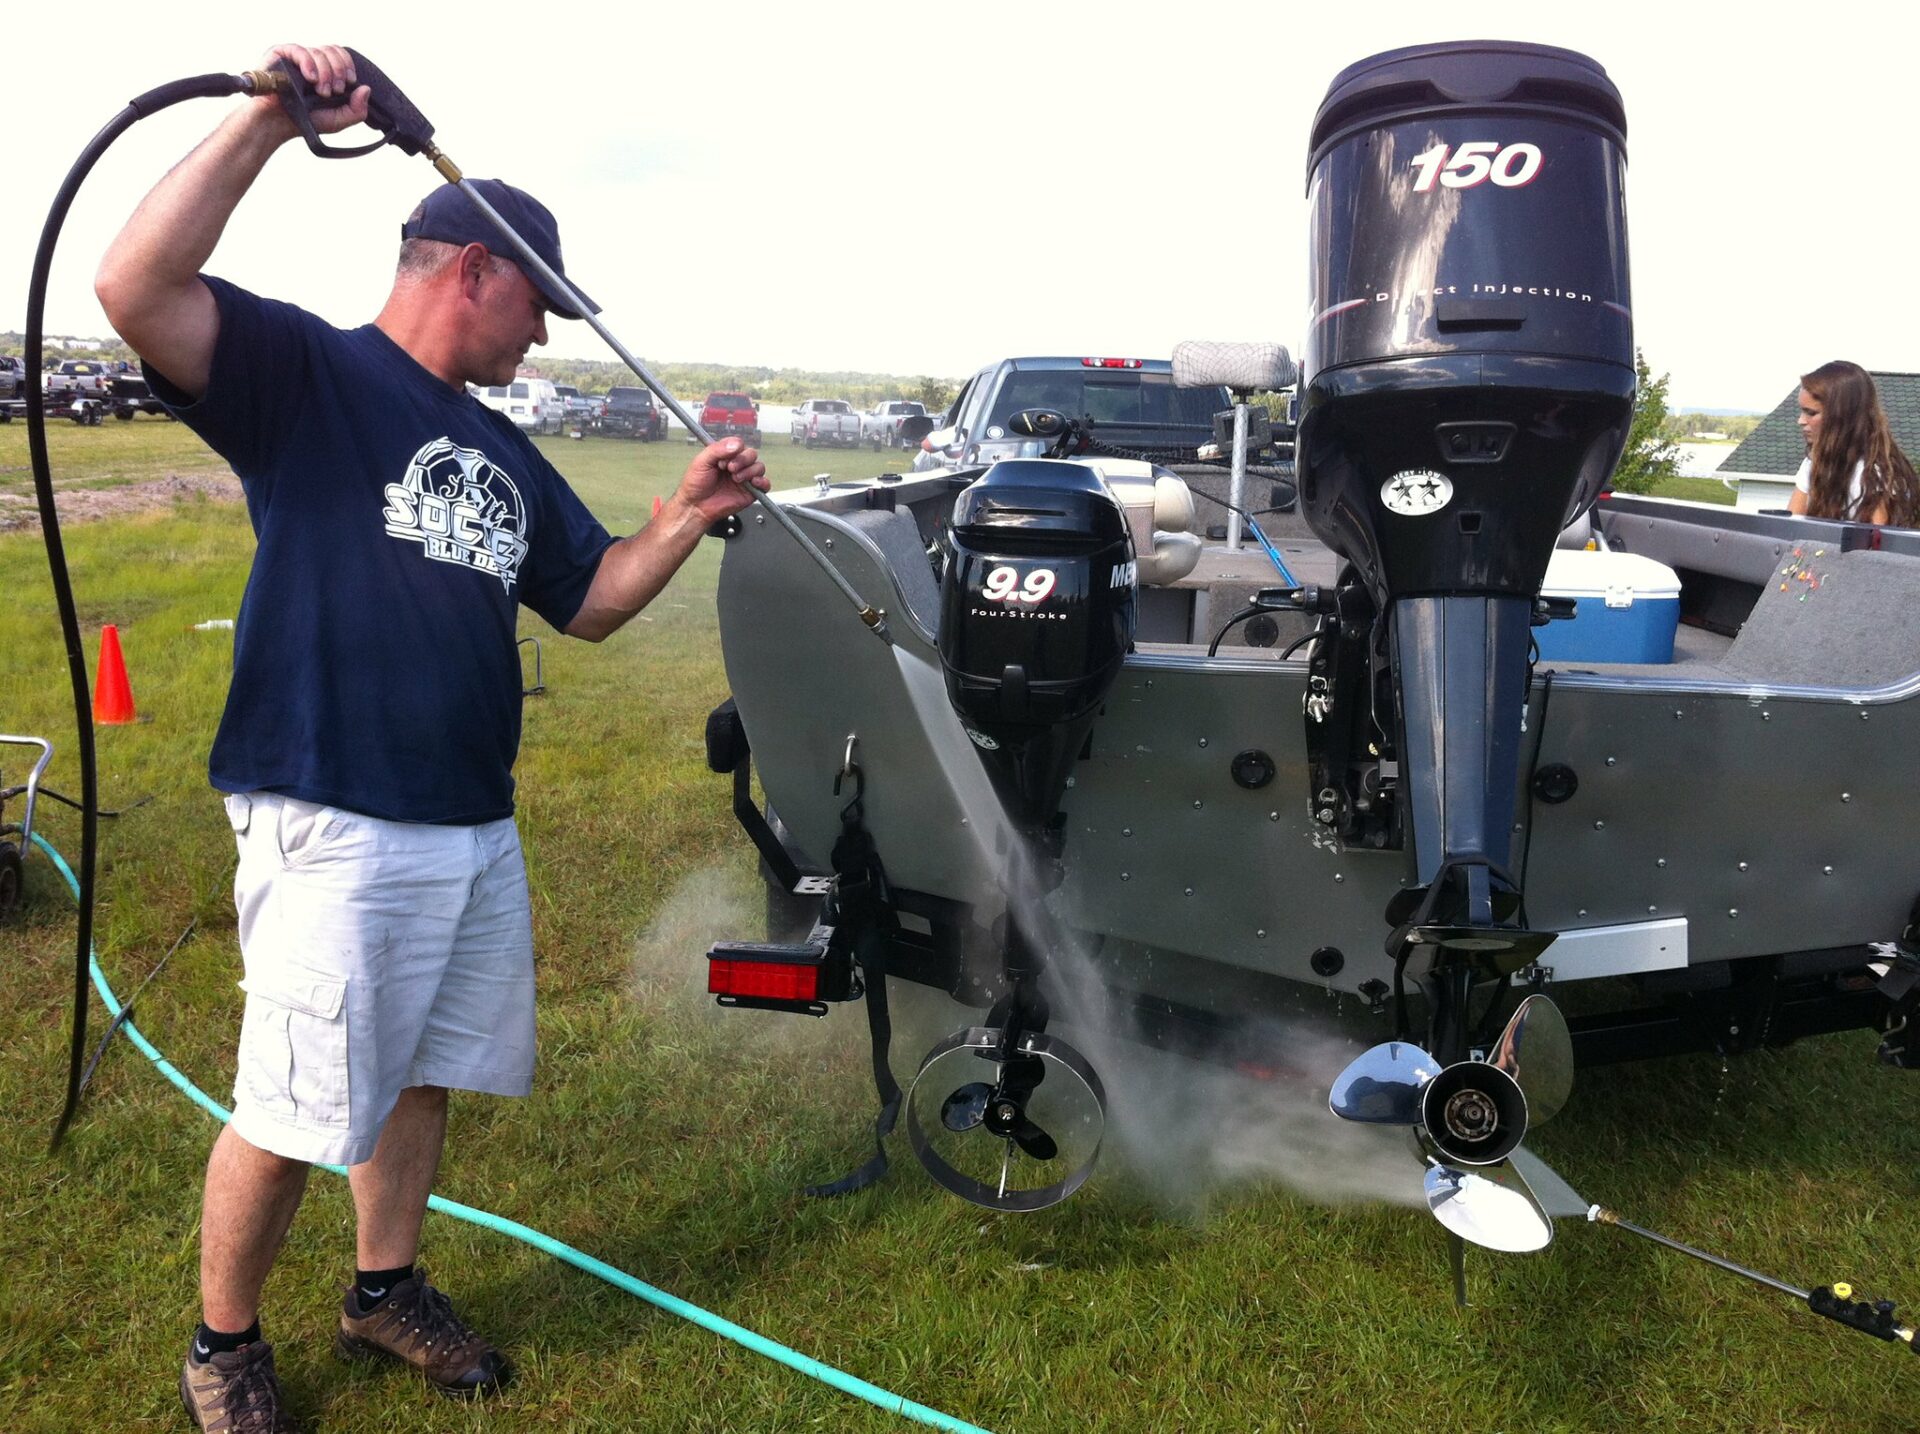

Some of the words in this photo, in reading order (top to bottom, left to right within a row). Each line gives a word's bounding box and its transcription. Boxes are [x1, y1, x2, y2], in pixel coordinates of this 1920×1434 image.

[1410, 142, 1544, 193] 150
[1474, 284, 1592, 302] Injection
[429, 538, 471, 563] BLUE
[982, 567, 1056, 602] 9.9
[971, 608, 1067, 620] FourStroke
